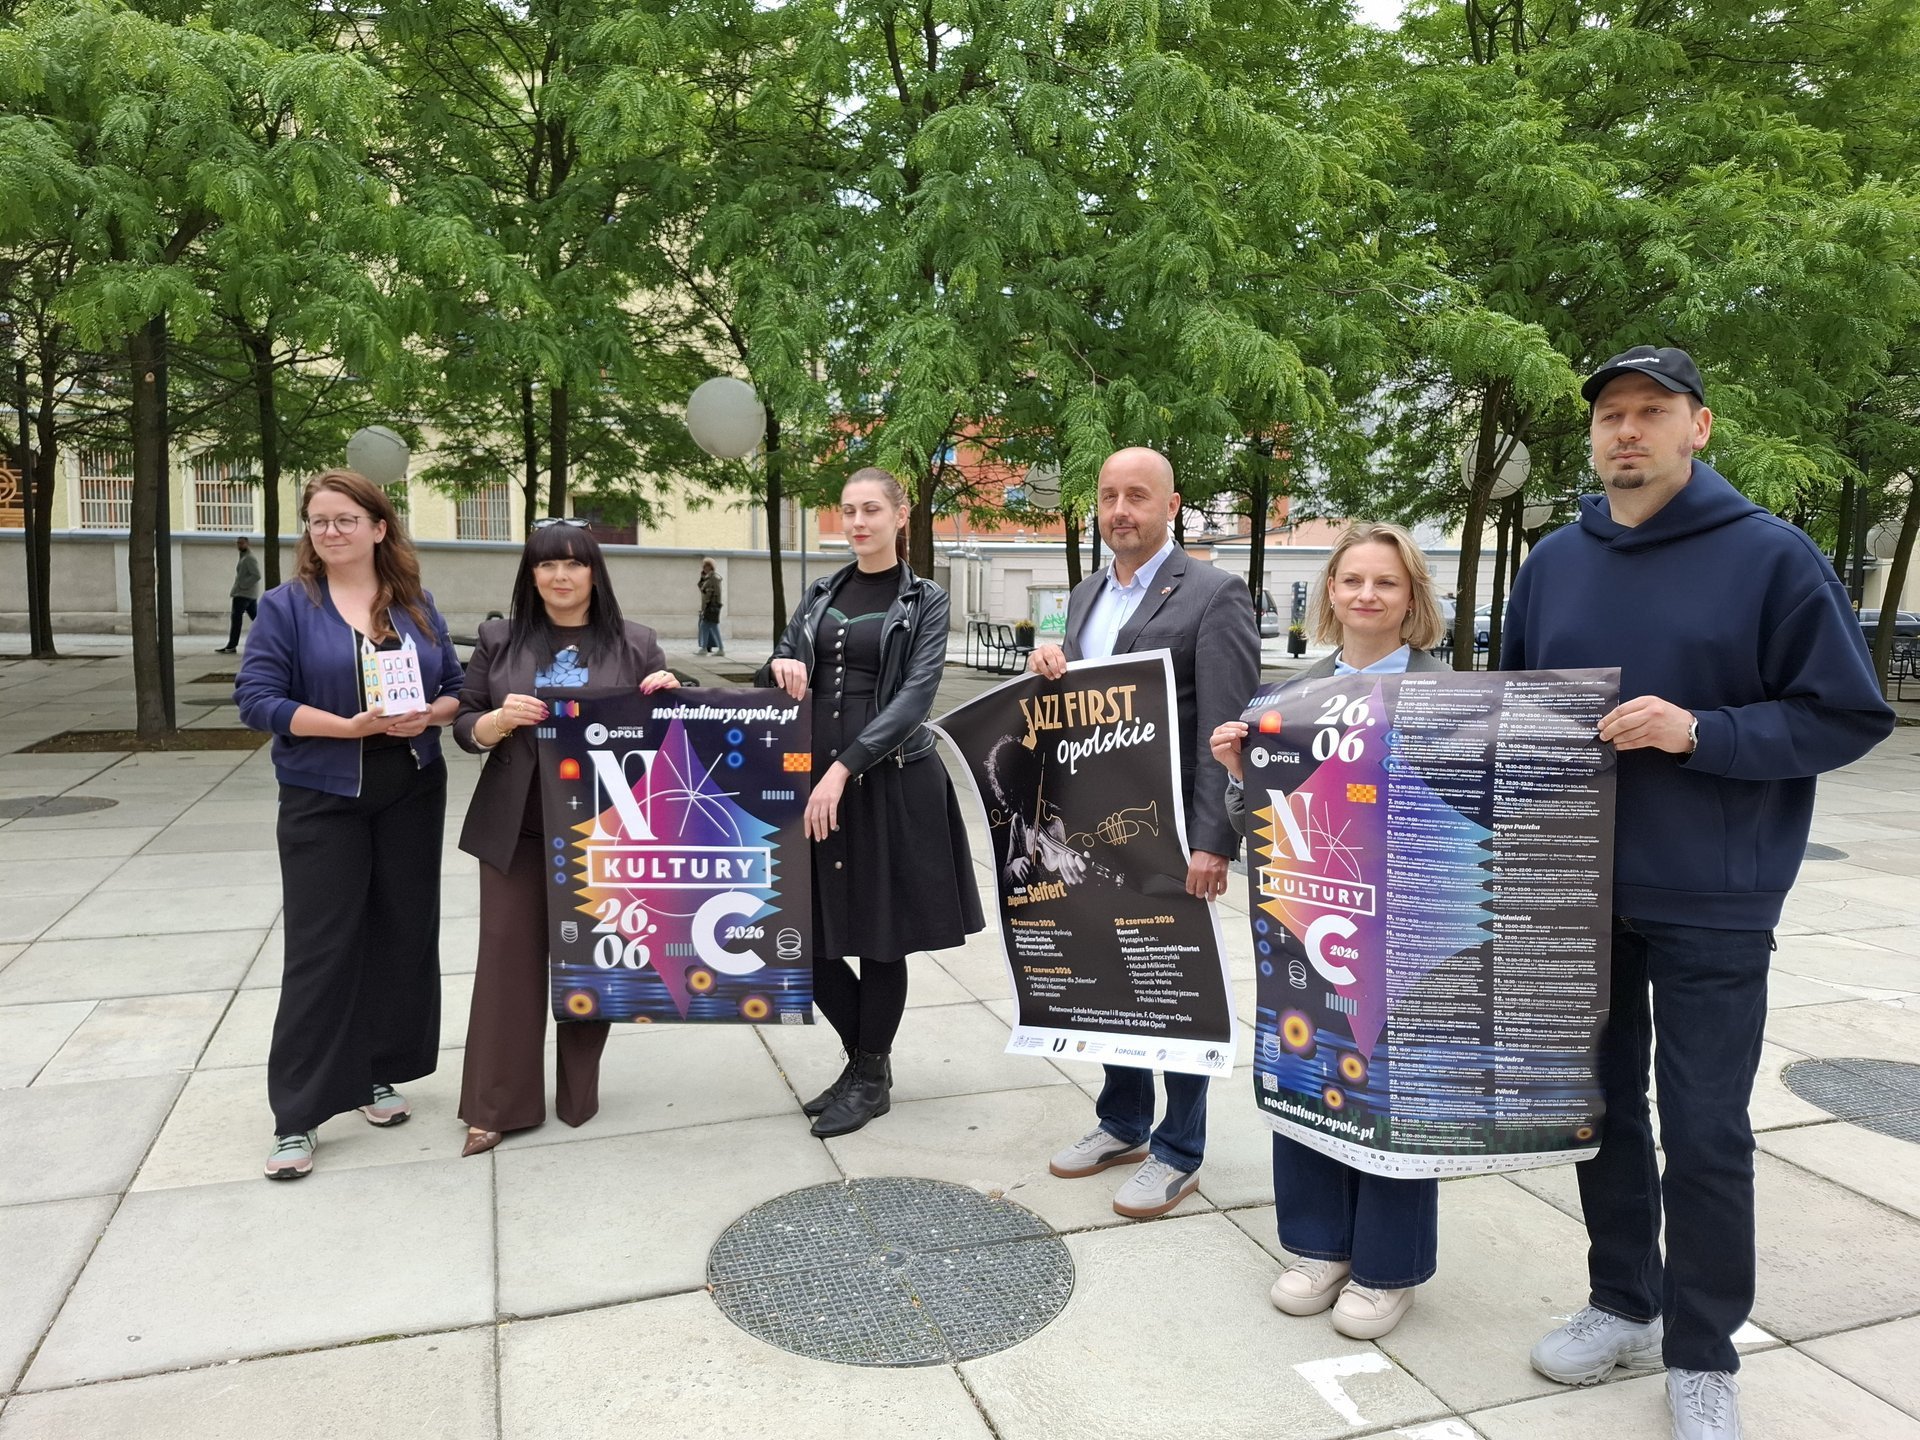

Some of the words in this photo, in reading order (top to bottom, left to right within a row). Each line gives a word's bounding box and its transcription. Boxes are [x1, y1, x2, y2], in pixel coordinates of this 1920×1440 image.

[652, 705, 798, 724] nockultury.opole.pl
[1020, 693, 1062, 750] JAZZ
[1065, 685, 1136, 728] FIRST
[1314, 695, 1376, 726] 26.
[609, 730, 643, 738] OPOLE
[1312, 727, 1366, 763] 06
[1271, 754, 1299, 764] OPOLE
[587, 750, 658, 840] N
[1266, 789, 1316, 862] N
[604, 858, 753, 879] KULTURY
[1027, 881, 1067, 902] Seifert
[1269, 876, 1364, 907] KULTURY
[591, 898, 657, 933] 26.
[1115, 918, 1124, 926] 28
[1155, 916, 1174, 924] 2026
[691, 891, 766, 975] C
[724, 926, 764, 939] 2026
[594, 935, 650, 969] 06
[1305, 915, 1358, 985] C
[1330, 944, 1359, 960] 2026
[1151, 1021, 1166, 1029] Opole
[1118, 1048, 1146, 1056] OPOLSKIE
[1264, 1097, 1374, 1141] nockultury.opole.pl
